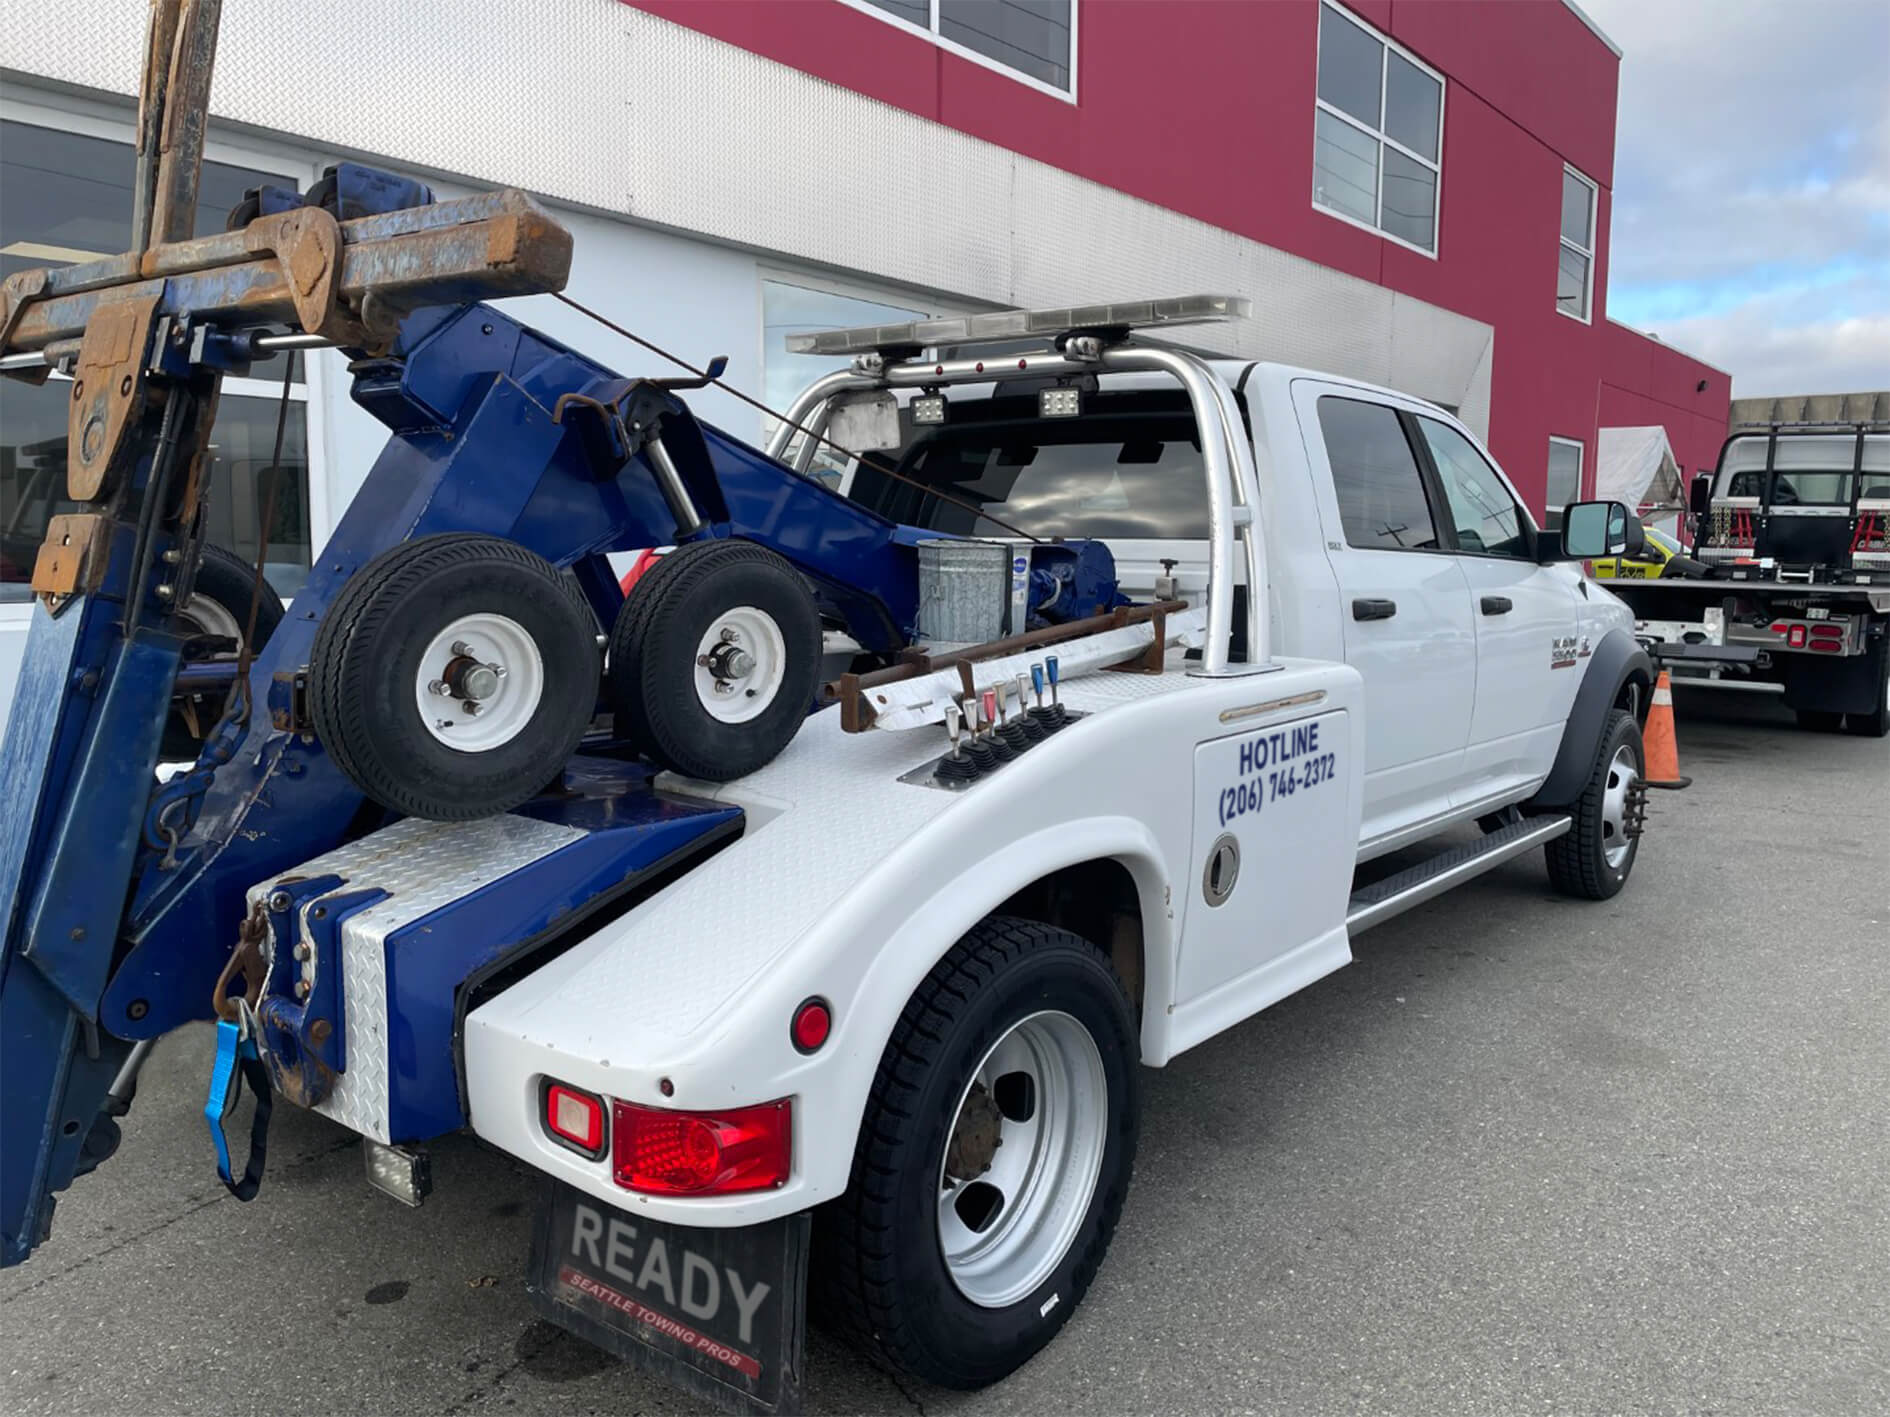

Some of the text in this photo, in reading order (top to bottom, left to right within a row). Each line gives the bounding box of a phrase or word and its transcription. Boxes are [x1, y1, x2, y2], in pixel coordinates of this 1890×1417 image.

[1218, 752, 1336, 828] (206) 746-2372
[1239, 722, 1319, 777] HOTLINE
[571, 1203, 771, 1344] READY
[570, 1273, 742, 1367] SEATTLE TOWING PROS
